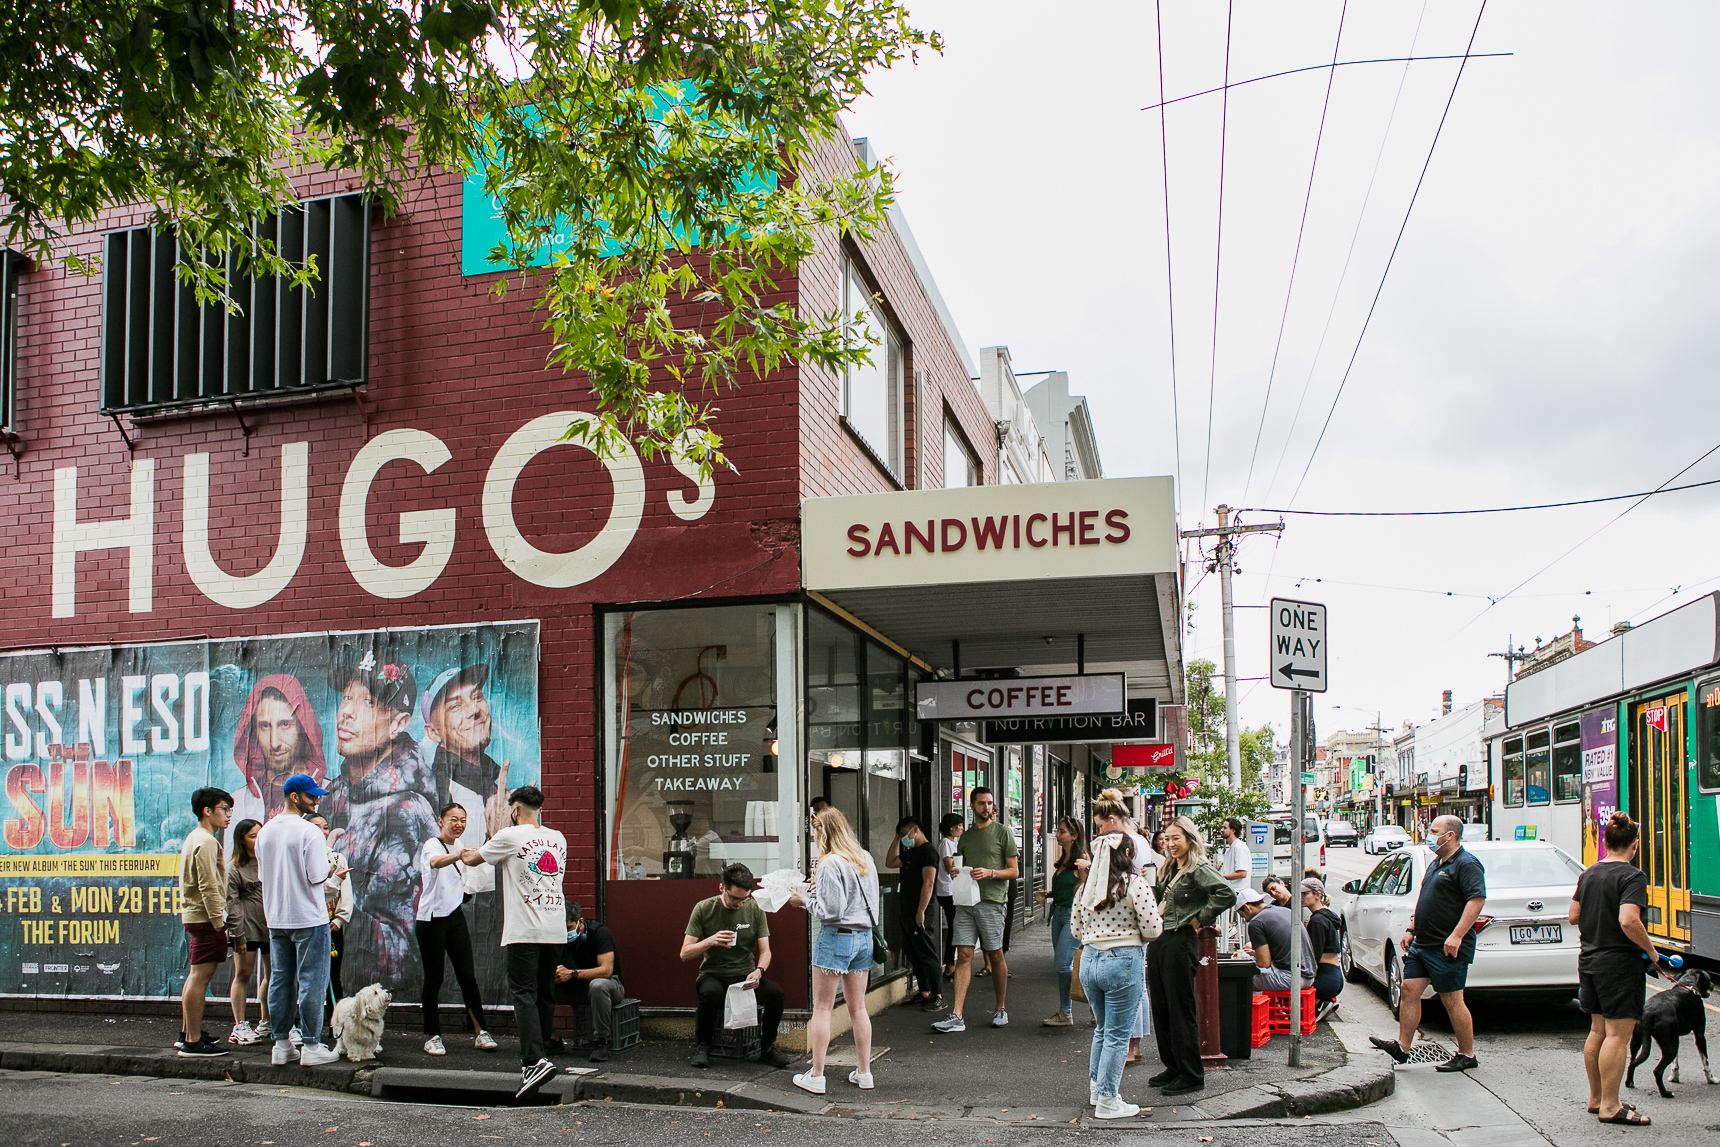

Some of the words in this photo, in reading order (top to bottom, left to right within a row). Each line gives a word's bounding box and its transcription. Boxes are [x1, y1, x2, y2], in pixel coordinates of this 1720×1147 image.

[846, 509, 1131, 557] SANDWICHES
[1279, 607, 1318, 631] ONE
[1277, 634, 1321, 658] WAY
[966, 685, 1072, 710] COFFEE
[78, 678, 106, 756] N
[121, 671, 210, 755] ESO
[651, 711, 747, 725] SANDWICHES
[1111, 712, 1146, 727] BAR
[1646, 708, 1664, 723] STOP
[669, 732, 728, 746] COFFEE
[47, 742, 90, 763] THE
[647, 755, 700, 768] OTHER
[704, 753, 751, 767] STUFF
[1151, 746, 1173, 763] Grill'd
[1585, 750, 1605, 767] RATED
[1596, 765, 1613, 777] VALUE
[654, 777, 743, 791] TAKEAWAY
[3, 760, 136, 850] SUN
[517, 839, 544, 860] KATSU
[12, 861, 31, 872] NEW
[32, 860, 59, 872] ALBUM
[100, 860, 118, 871] THIS
[119, 859, 161, 871] FEBRUARY
[7, 887, 42, 913] FEB
[51, 895, 63, 914] &
[71, 887, 113, 913] MON
[118, 887, 143, 913] 28
[21, 920, 54, 944] THE
[58, 920, 120, 944] FORUM
[1513, 928, 1532, 939] 1GQ
[1541, 927, 1559, 938] 1VY
